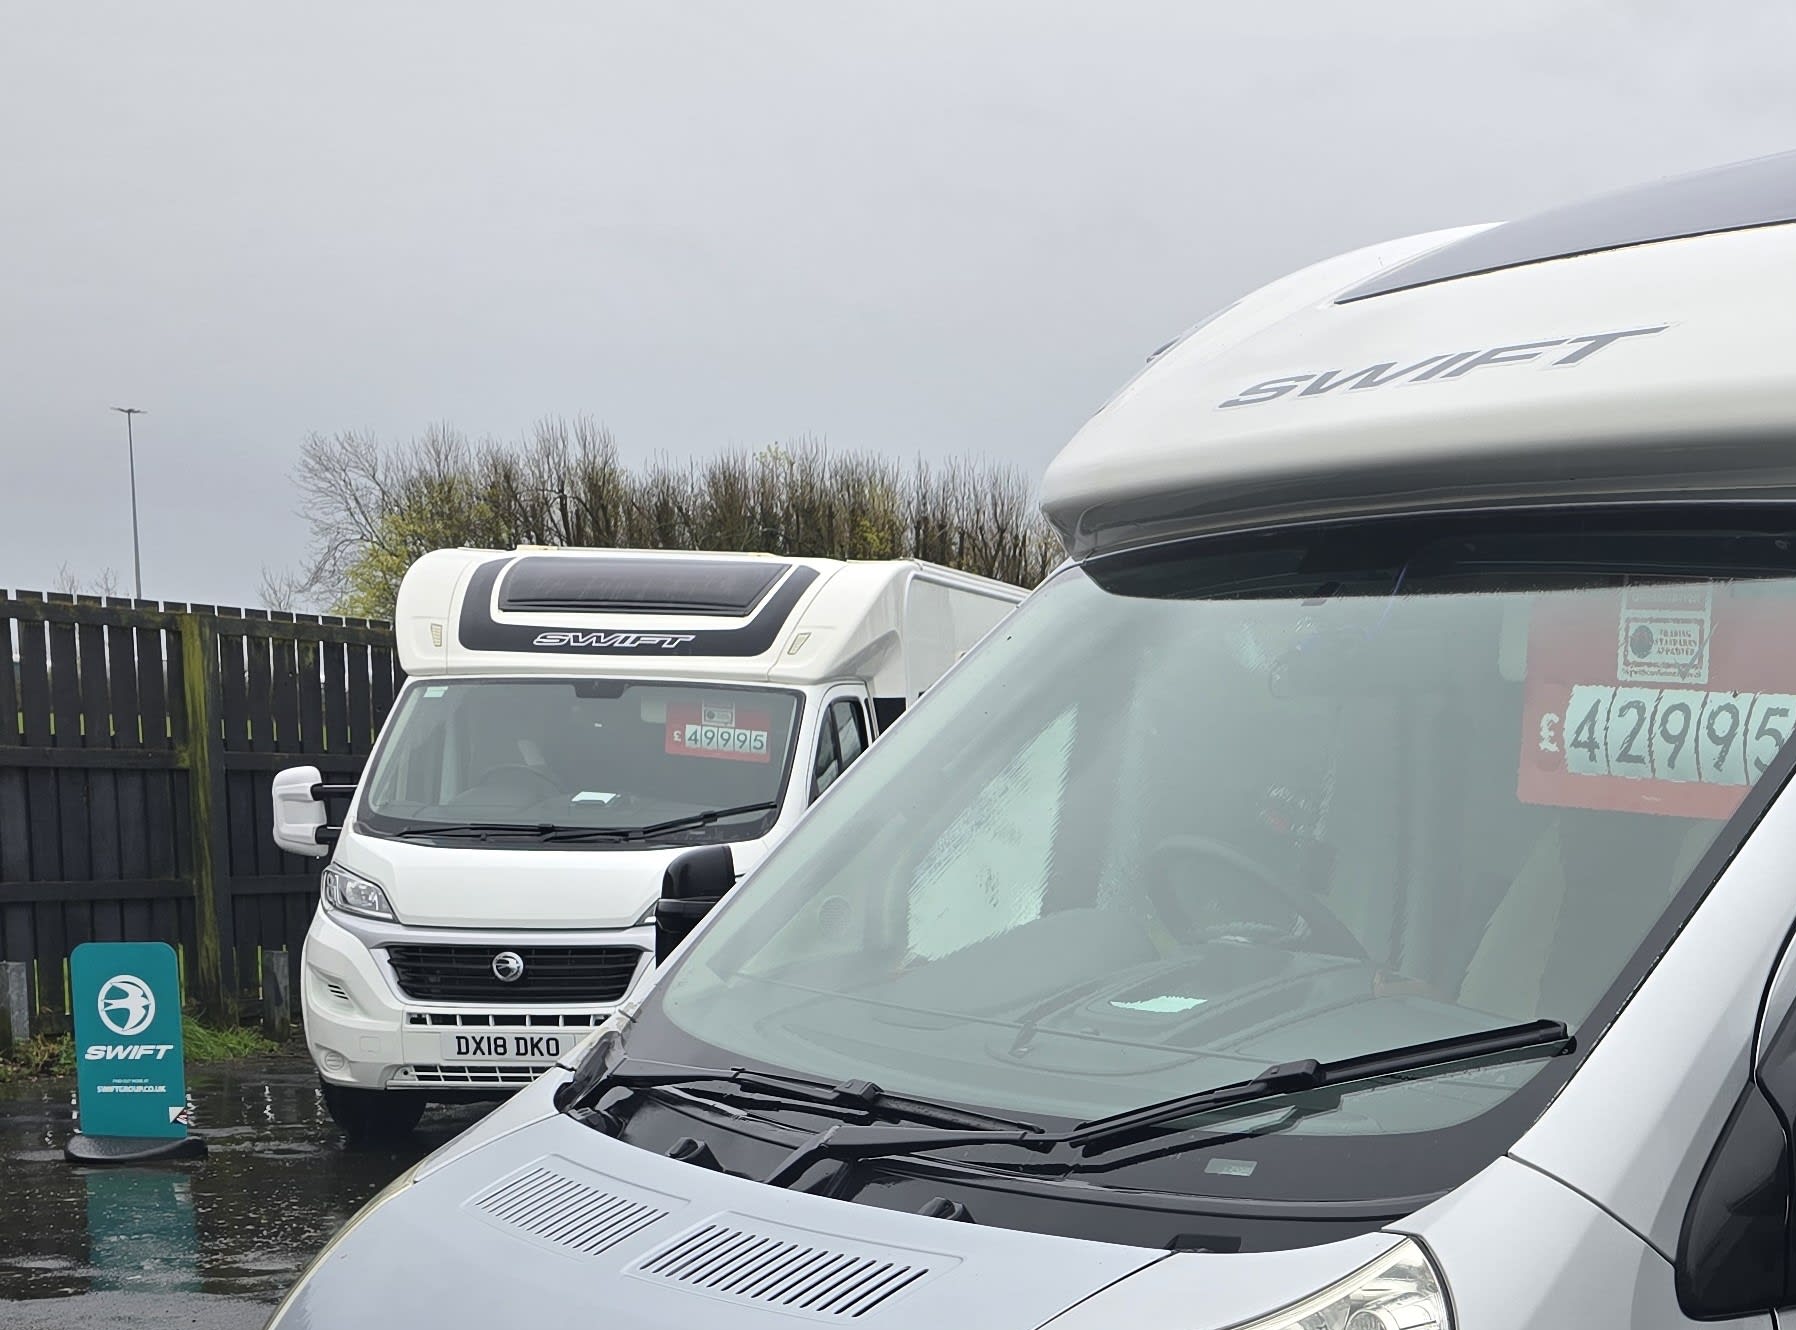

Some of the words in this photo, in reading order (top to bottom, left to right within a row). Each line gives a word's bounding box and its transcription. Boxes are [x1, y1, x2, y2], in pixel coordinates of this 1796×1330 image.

[1218, 325, 1672, 409] SWIFT
[533, 632, 696, 648] SWIFT
[85, 1045, 173, 1060] SWIFT
[456, 1036, 507, 1056] DX18
[515, 1037, 560, 1057] DKO
